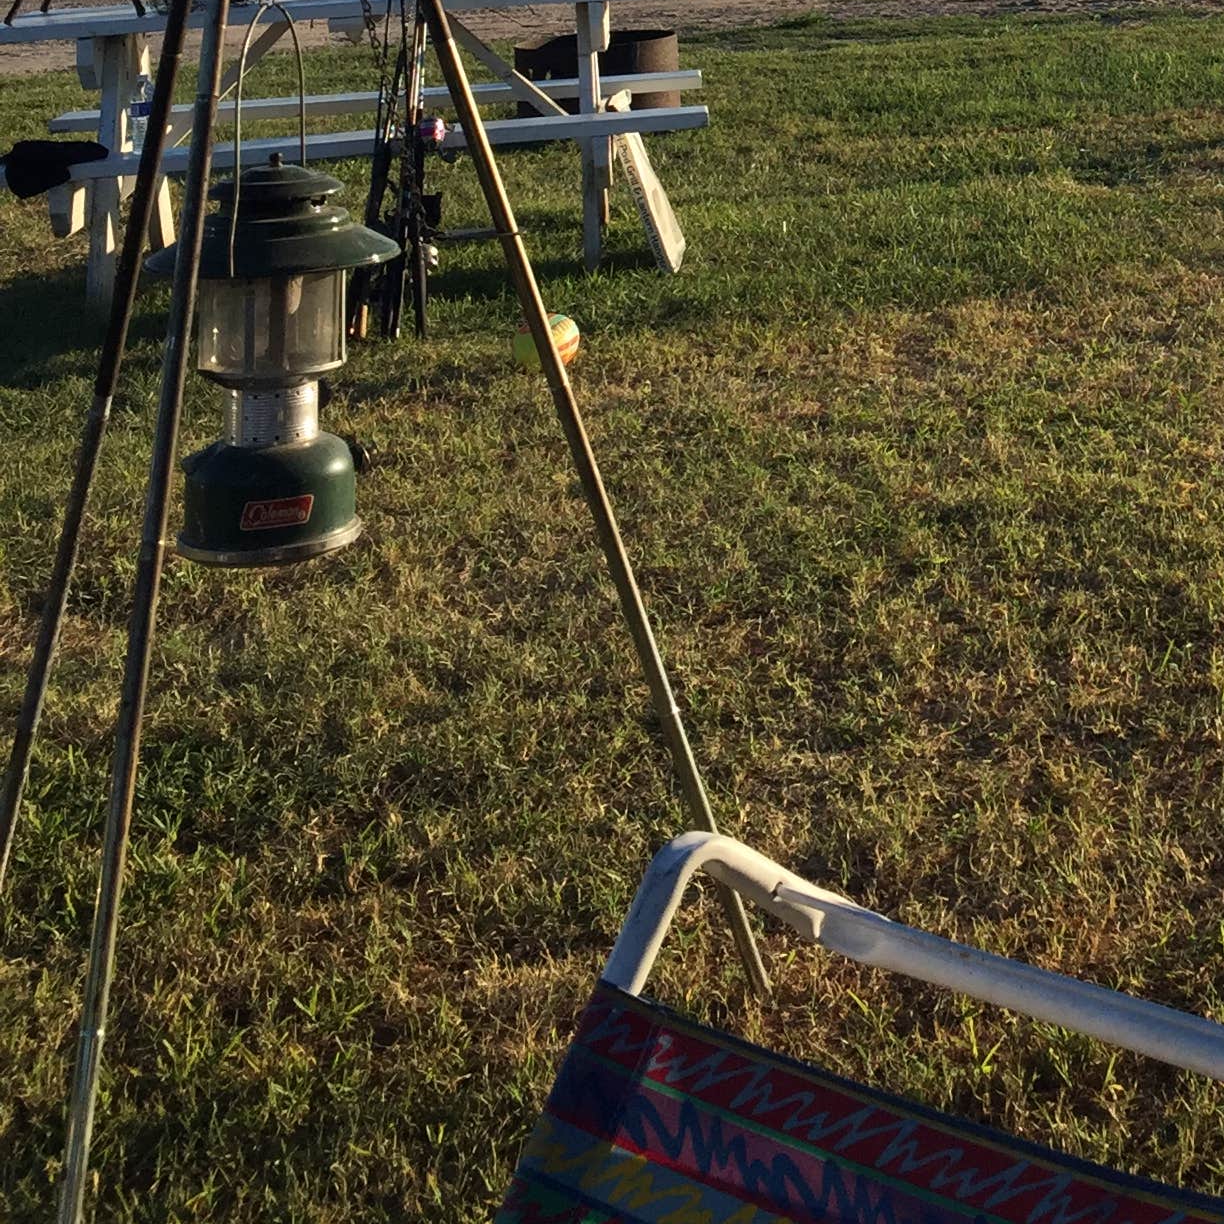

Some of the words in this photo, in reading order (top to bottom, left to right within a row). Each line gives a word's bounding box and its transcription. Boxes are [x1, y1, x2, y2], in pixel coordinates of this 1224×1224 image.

[616, 136, 631, 164] i-Pod
[625, 164, 639, 185] Grill
[636, 196, 654, 233] Lantern
